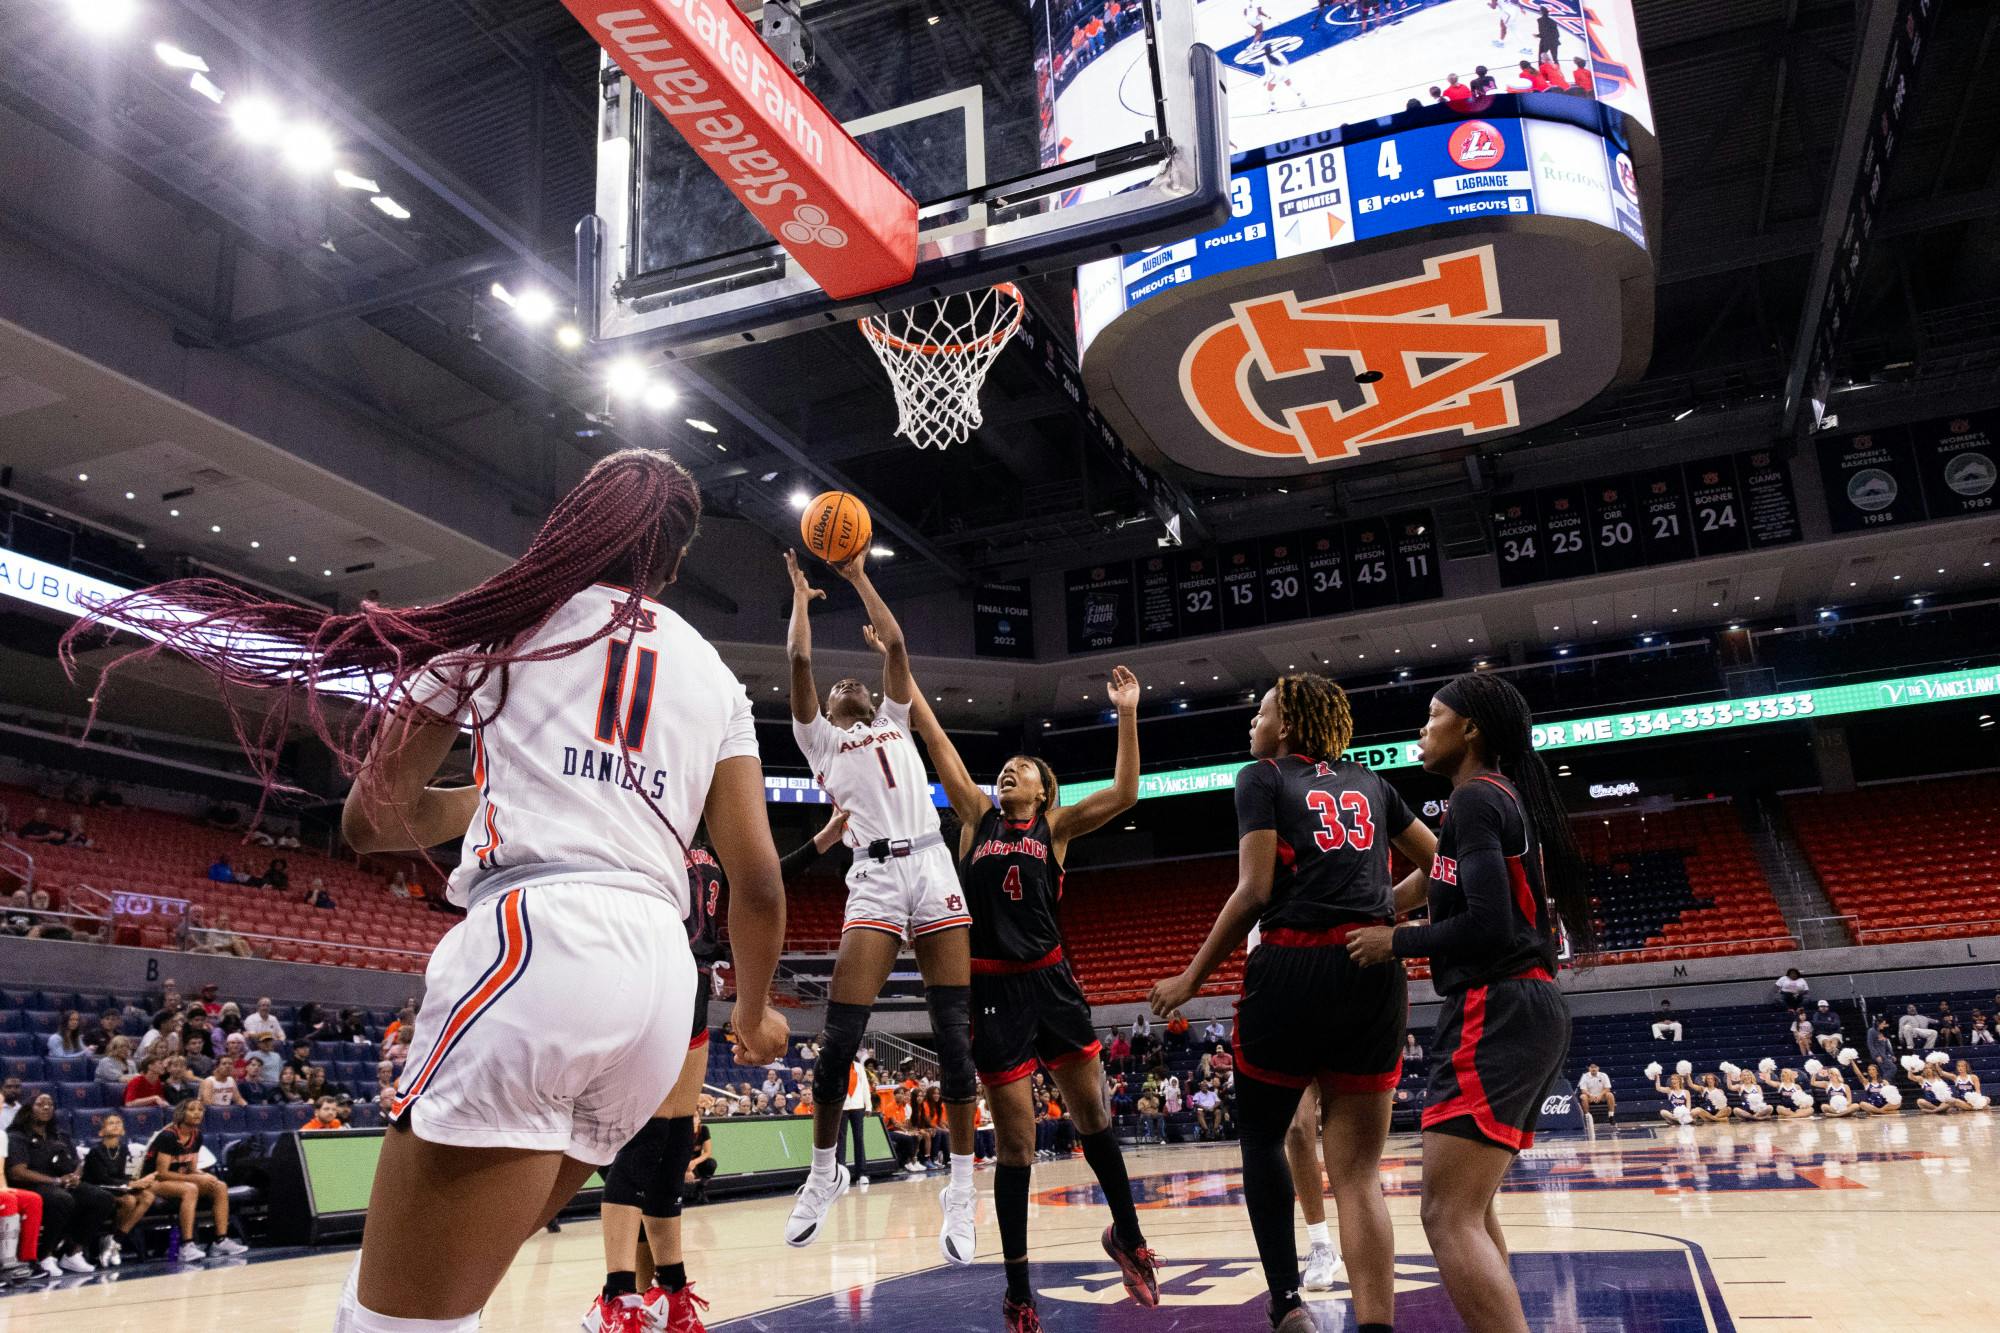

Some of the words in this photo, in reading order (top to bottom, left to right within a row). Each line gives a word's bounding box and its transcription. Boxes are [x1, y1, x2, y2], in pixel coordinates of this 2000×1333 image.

[672, 0, 823, 166] tateFarm
[1377, 139, 1402, 181] 4
[1278, 152, 1337, 194] 2:18
[1456, 174, 1509, 191] LAGRANGE
[1295, 192, 1338, 212] QUARTER
[1366, 199, 1374, 211] 3
[1384, 188, 1425, 206] FOULS
[1448, 200, 1509, 215] TIMEOUTS
[1514, 198, 1521, 209] 3
[1204, 232, 1243, 249] FOULS
[1251, 226, 1259, 239] 3
[1142, 249, 1173, 274] AUBURN
[1130, 273, 1176, 301] TIMEOUTS
[1649, 501, 1677, 513] JONES
[1961, 497, 1993, 510] 1989
[813, 505, 834, 550] Wilson
[1651, 514, 1680, 540] 21
[1699, 504, 1737, 532] 24
[1863, 512, 1894, 525] 1988
[1551, 530, 1583, 555] 25
[1600, 522, 1633, 547] 50
[1503, 537, 1537, 562] 34
[1356, 561, 1387, 584] 45
[1406, 554, 1428, 578] 11
[0, 562, 122, 612] AUBUR
[1270, 576, 1299, 600] 30
[1312, 569, 1343, 592] 34
[1186, 590, 1214, 613] 32
[1230, 583, 1253, 605] 15
[977, 604, 1003, 615] FINAL
[1004, 607, 1029, 617] FOUR
[1087, 612, 1113, 624] FOUR
[1088, 602, 1114, 615] FINAL
[993, 636, 1016, 646] 2022
[1090, 636, 1113, 647] 2019
[594, 637, 658, 752] 11
[1909, 685, 1923, 696] THE
[1915, 679, 1968, 699] VANCE
[1967, 677, 1994, 693] LAW
[1573, 719, 1612, 742] ME
[1620, 693, 1815, 737] 334-333-3333
[874, 746, 897, 789] 1
[1152, 776, 1190, 793] VANCE
[1190, 775, 1209, 790] LAW
[1210, 772, 1234, 787] FIRM
[1305, 789, 1376, 853] 33
[1002, 864, 1023, 900] 4
[1967, 943, 1977, 959] L
[146, 957, 159, 982] B
[1673, 964, 1688, 977] M
